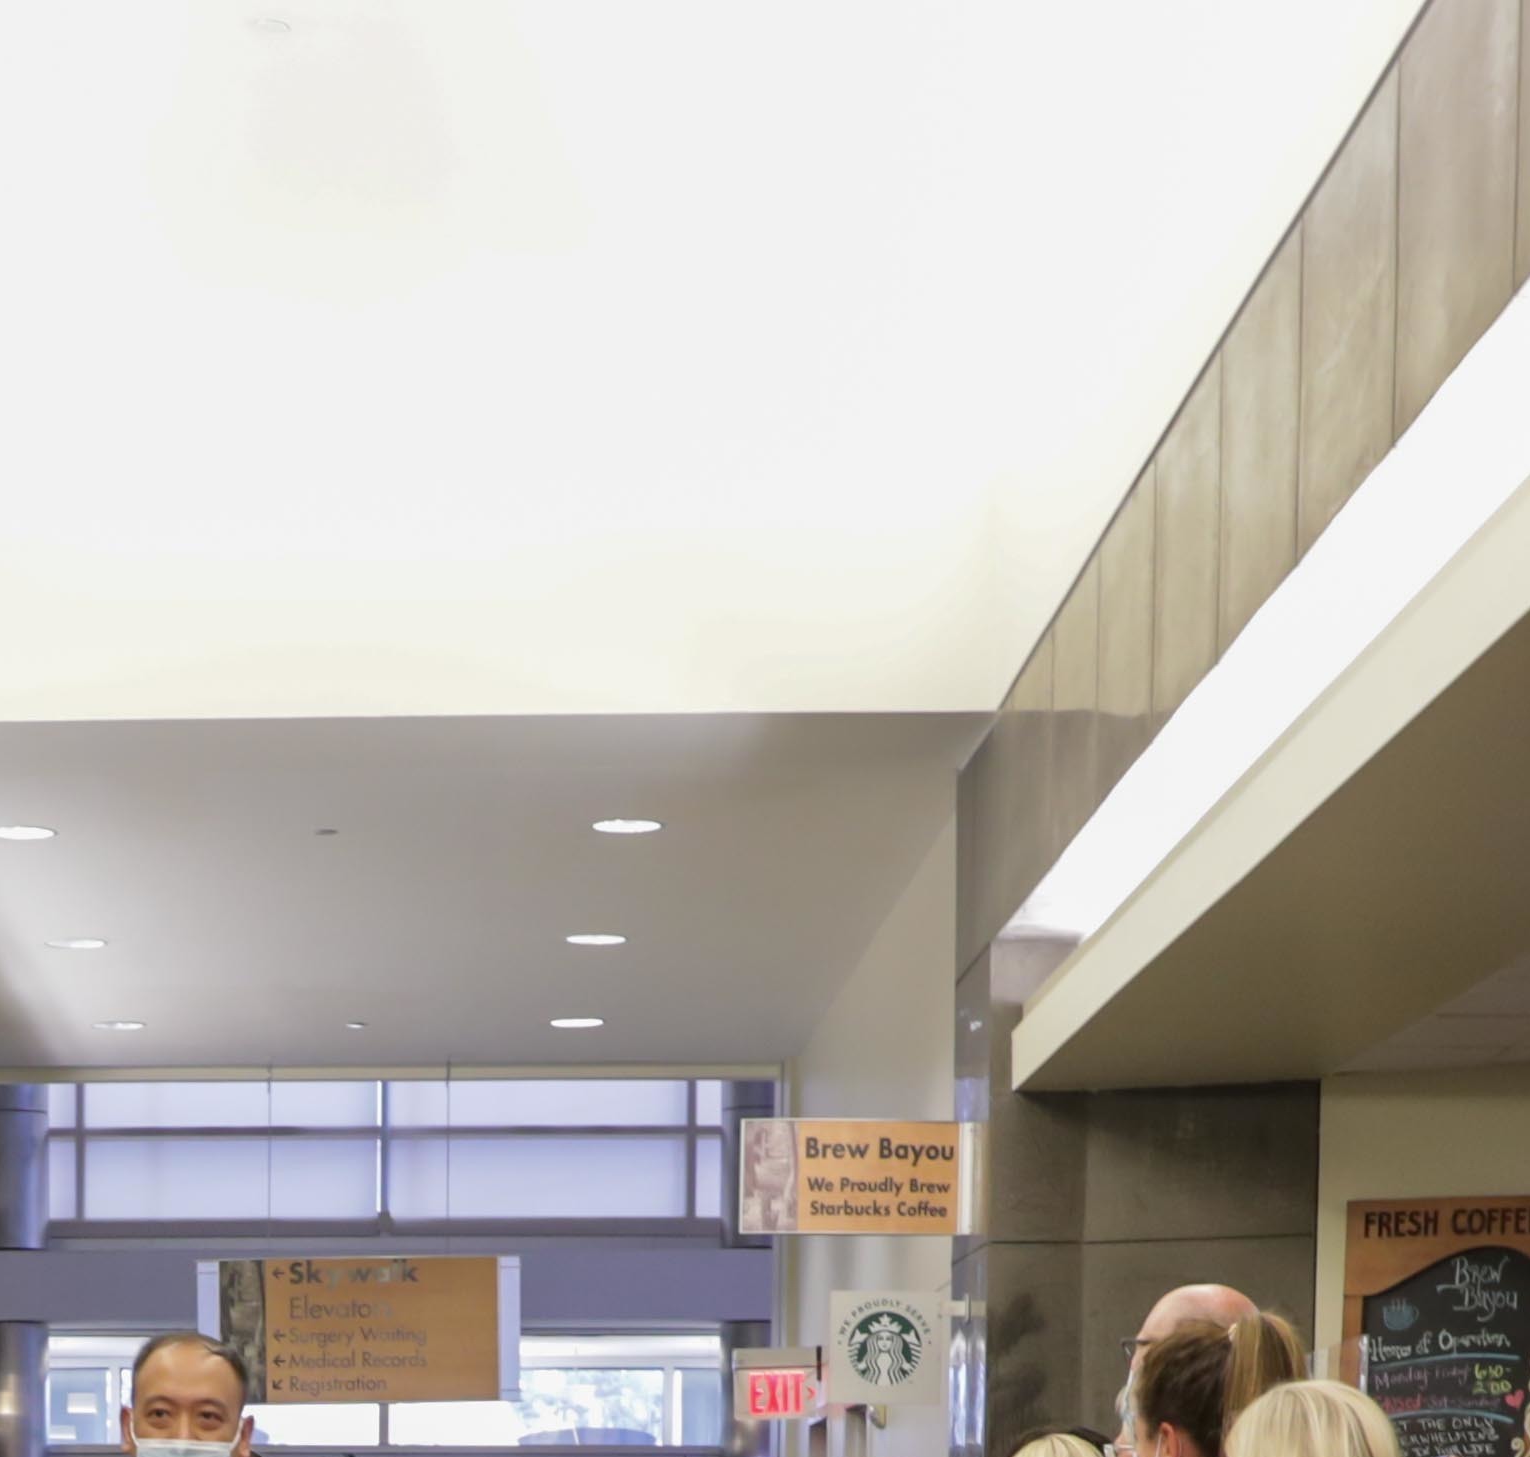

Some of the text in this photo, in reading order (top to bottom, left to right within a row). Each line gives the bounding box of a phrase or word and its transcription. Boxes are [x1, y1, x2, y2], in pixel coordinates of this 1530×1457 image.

[805, 1136, 955, 1168] Brew Bayou
[807, 1176, 951, 1197] We Proudly Brew
[810, 1200, 948, 1218] Starbucks Coffee
[1363, 1209, 1439, 1239] FRESH
[289, 1325, 428, 1347] Surgery Waiting
[289, 1350, 429, 1369] Medical Records
[289, 1375, 388, 1397] Registration
[749, 1372, 807, 1415] EXIT
